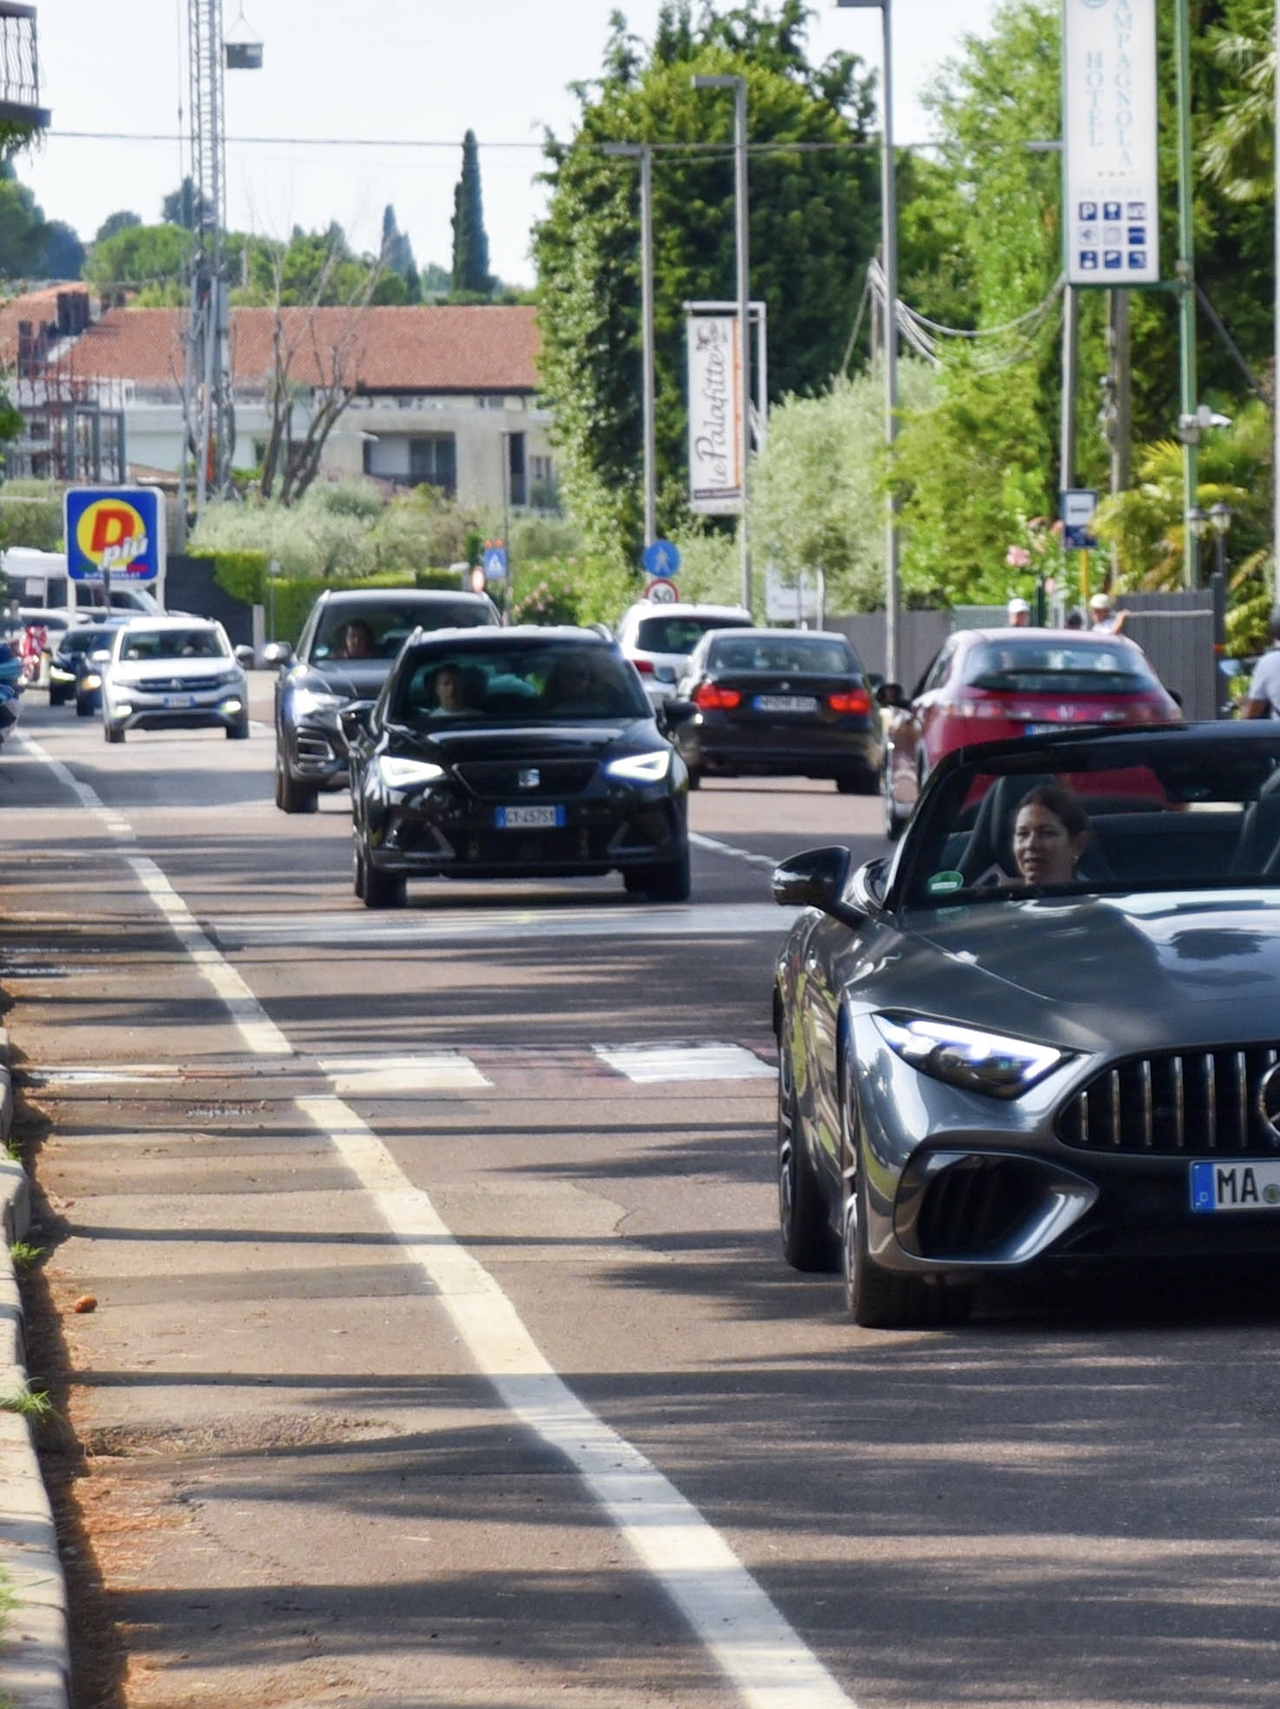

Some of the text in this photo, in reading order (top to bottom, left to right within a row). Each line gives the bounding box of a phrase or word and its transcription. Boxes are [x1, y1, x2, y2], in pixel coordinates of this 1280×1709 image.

[1085, 50, 1105, 147] HOTEL
[91, 508, 135, 551] D
[1216, 1167, 1260, 1203] MA
